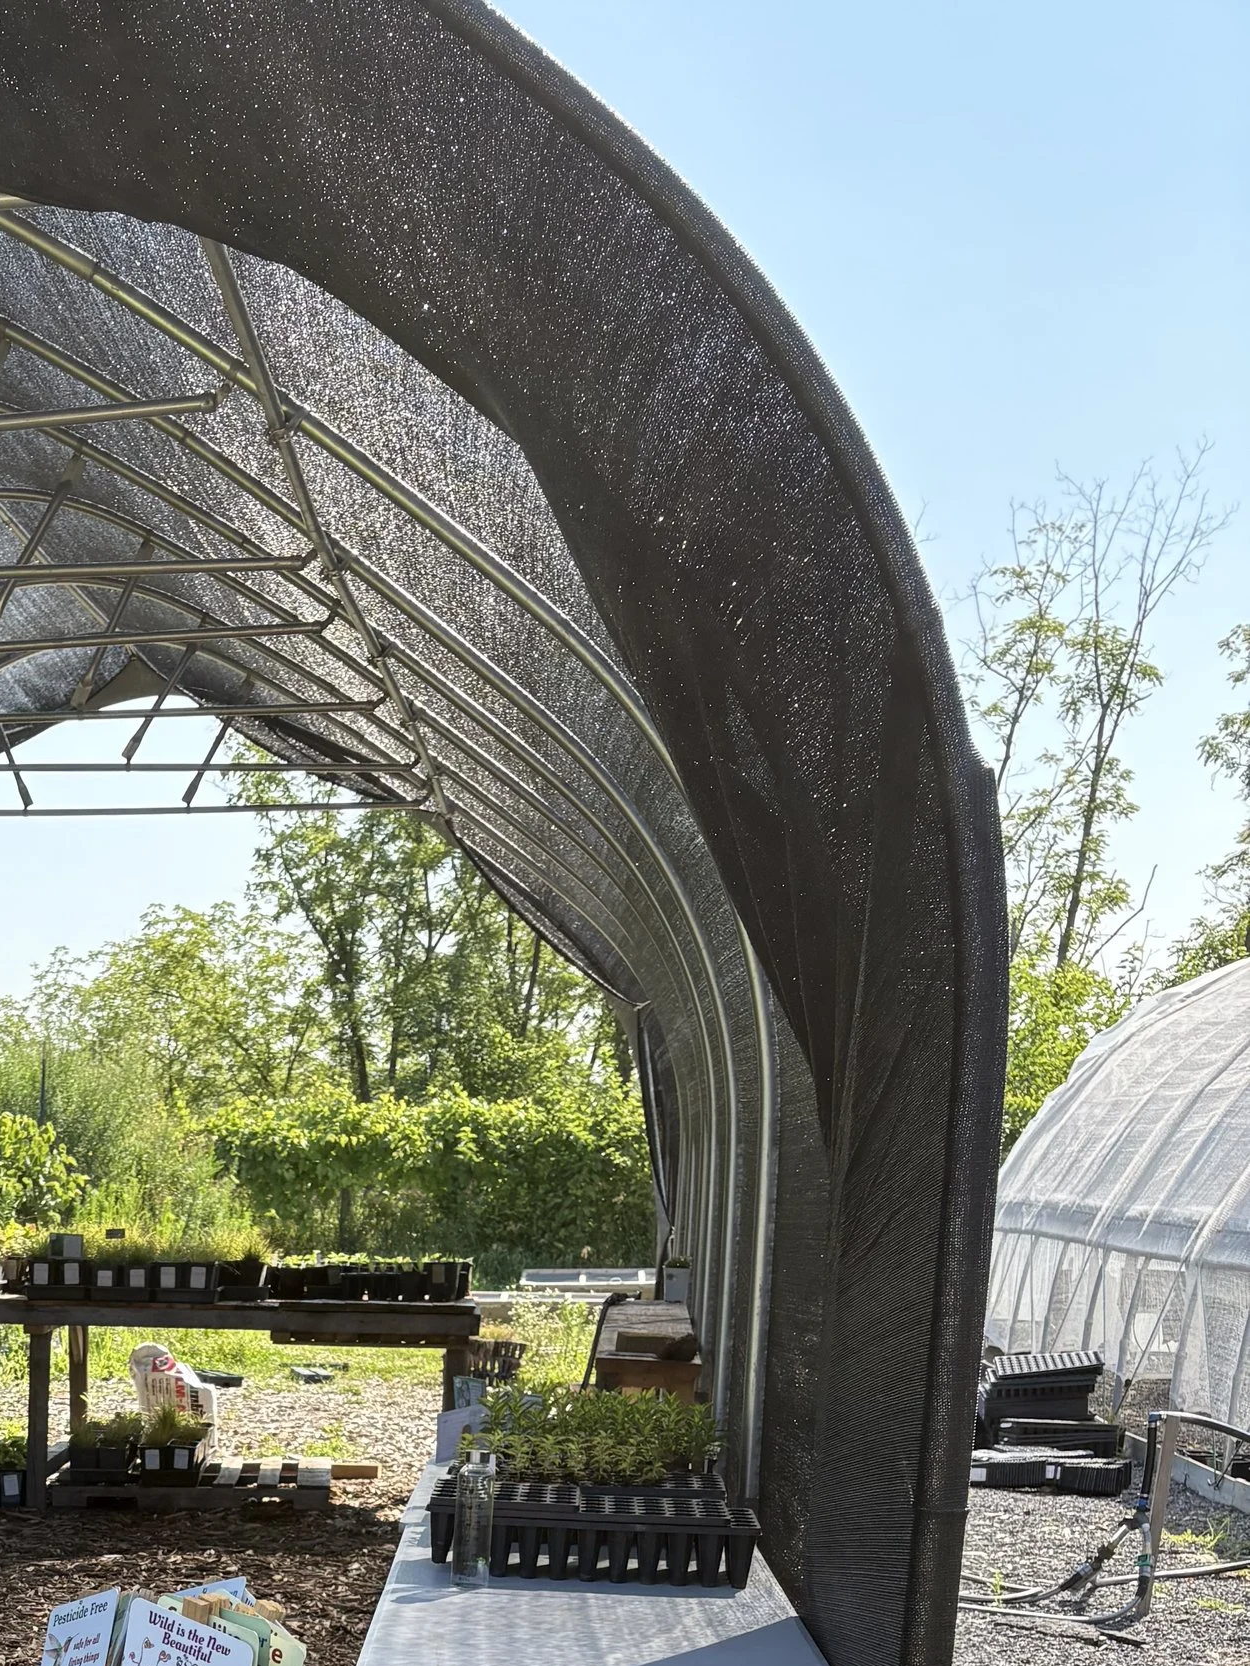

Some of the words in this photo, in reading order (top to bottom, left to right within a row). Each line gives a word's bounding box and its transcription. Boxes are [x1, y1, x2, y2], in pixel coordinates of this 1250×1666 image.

[53, 1606, 88, 1627] Pesticide
[89, 1601, 109, 1617] Free
[73, 1638, 85, 1651] safe
[84, 1636, 93, 1649] for
[92, 1632, 101, 1646] all
[148, 1610, 176, 1633] Wild
[176, 1623, 186, 1638] is
[187, 1629, 205, 1646] the
[206, 1635, 231, 1657] New
[83, 1651, 100, 1665] things
[162, 1631, 213, 1664] Beautiful
